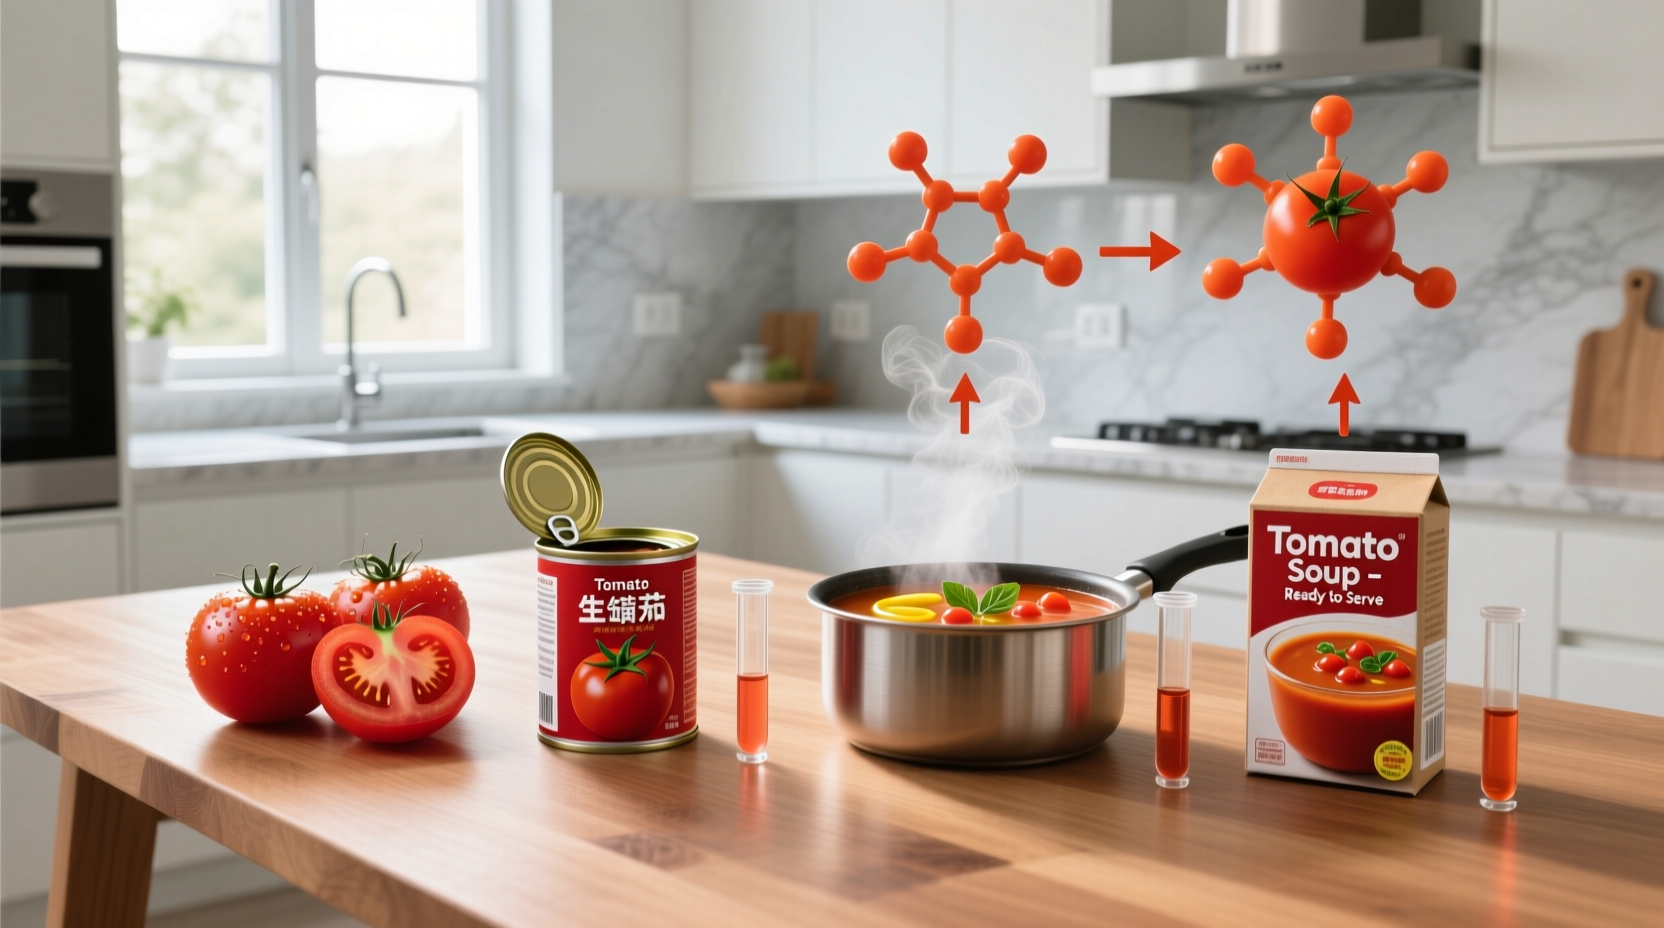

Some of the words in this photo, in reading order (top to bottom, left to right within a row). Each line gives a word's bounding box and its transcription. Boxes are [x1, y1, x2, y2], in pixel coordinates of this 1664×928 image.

[1266, 524, 1400, 562] Tomato
[594, 578, 649, 591] Tomato
[1287, 558, 1361, 591] Soup
[1284, 587, 1326, 605] Ready
[1329, 590, 1342, 604] to
[1346, 591, 1384, 606] Serve
